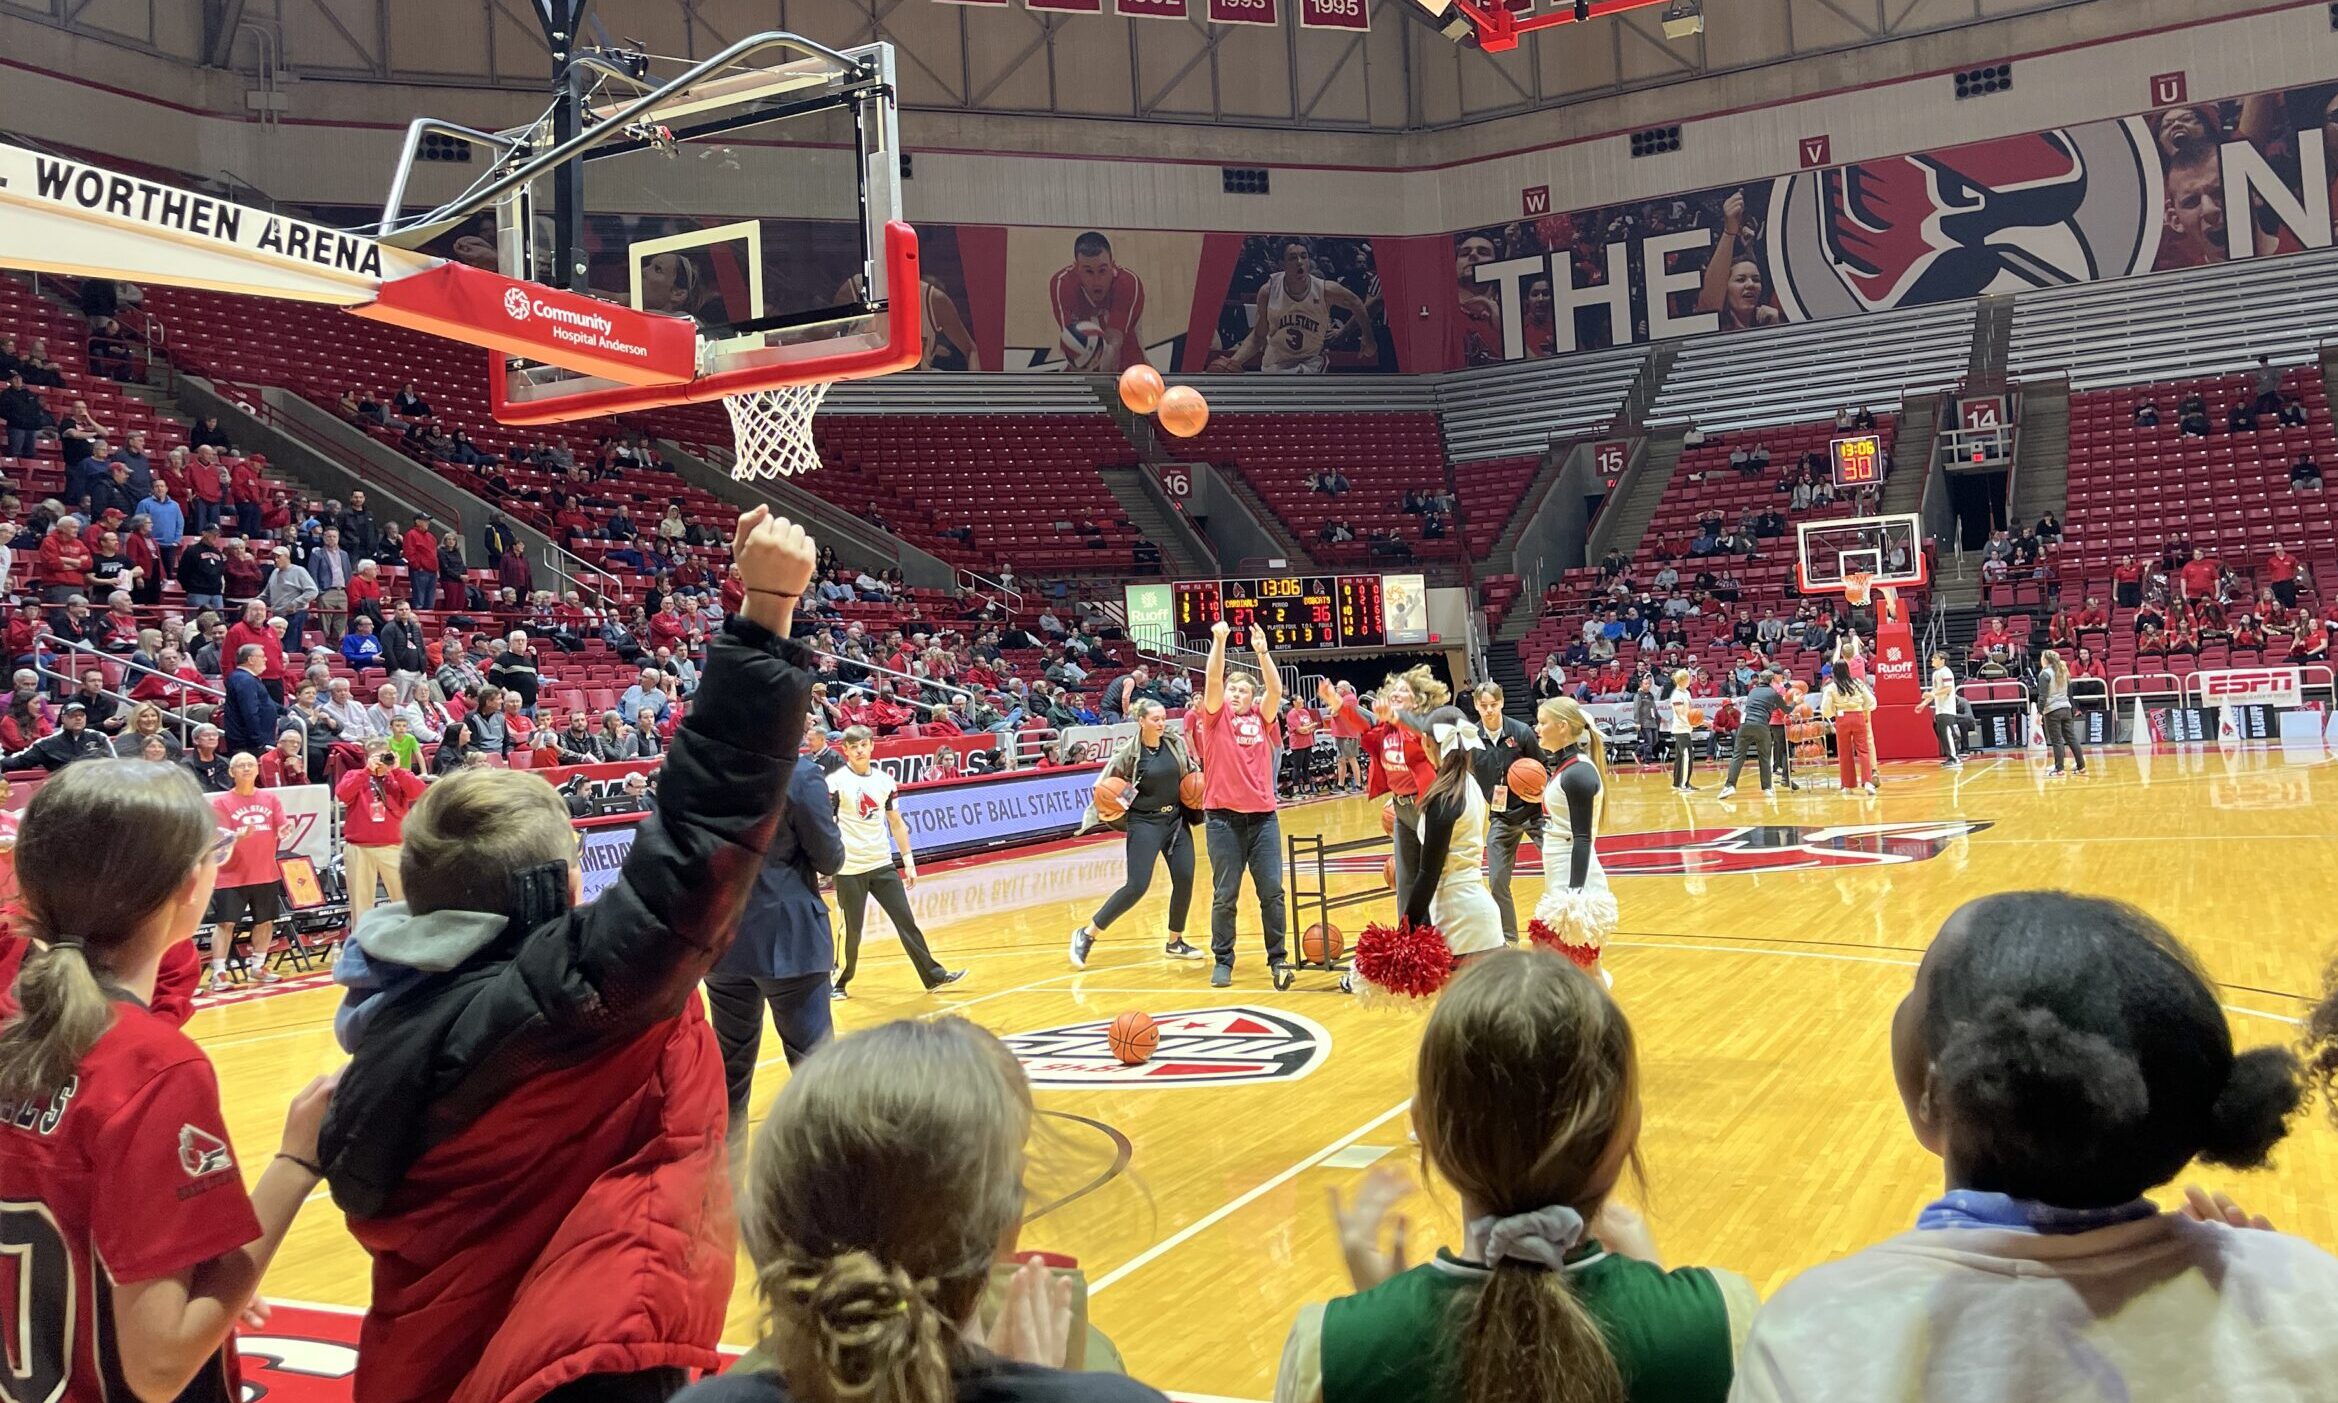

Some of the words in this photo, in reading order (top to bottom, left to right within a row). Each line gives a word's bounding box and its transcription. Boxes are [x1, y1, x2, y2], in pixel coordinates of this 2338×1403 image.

[1311, 0, 1360, 16] 1995
[2159, 81, 2179, 103] U
[1806, 144, 1823, 164] V
[1526, 193, 1546, 213] W
[35, 157, 241, 242] WORTHEN
[256, 217, 383, 278] ARENA
[1474, 227, 1720, 361] THE
[2220, 127, 2333, 260] N
[532, 299, 612, 336] Community
[553, 325, 597, 346] Hospital
[599, 335, 648, 357] Anderson
[1285, 328, 1304, 352] 3
[1967, 408, 1998, 429] 14
[1840, 441, 1875, 457] 13:06
[1597, 451, 1624, 473] 15
[1843, 456, 1873, 482] 30
[1163, 474, 1189, 496] 16
[1262, 578, 1301, 597] 13:06
[1224, 598, 1259, 609] CARDINALS
[1303, 596, 1331, 606] BOBCATS
[1131, 608, 1169, 622] Ruoff
[1235, 608, 1255, 626] 27
[1276, 608, 1285, 622] 2
[1312, 605, 1331, 622] 36
[1235, 631, 1244, 646] 0
[1304, 628, 1313, 643] 3
[1323, 627, 1333, 642] 0
[1877, 661, 1913, 674] Ruoff
[2208, 671, 2292, 695] ESPN
[2172, 708, 2185, 742] DEFENSE
[901, 805, 958, 836] STORE
[961, 801, 983, 827] OF
[988, 796, 1027, 824] BALL
[1027, 790, 1073, 816] STATE
[579, 841, 631, 874] MEDA
